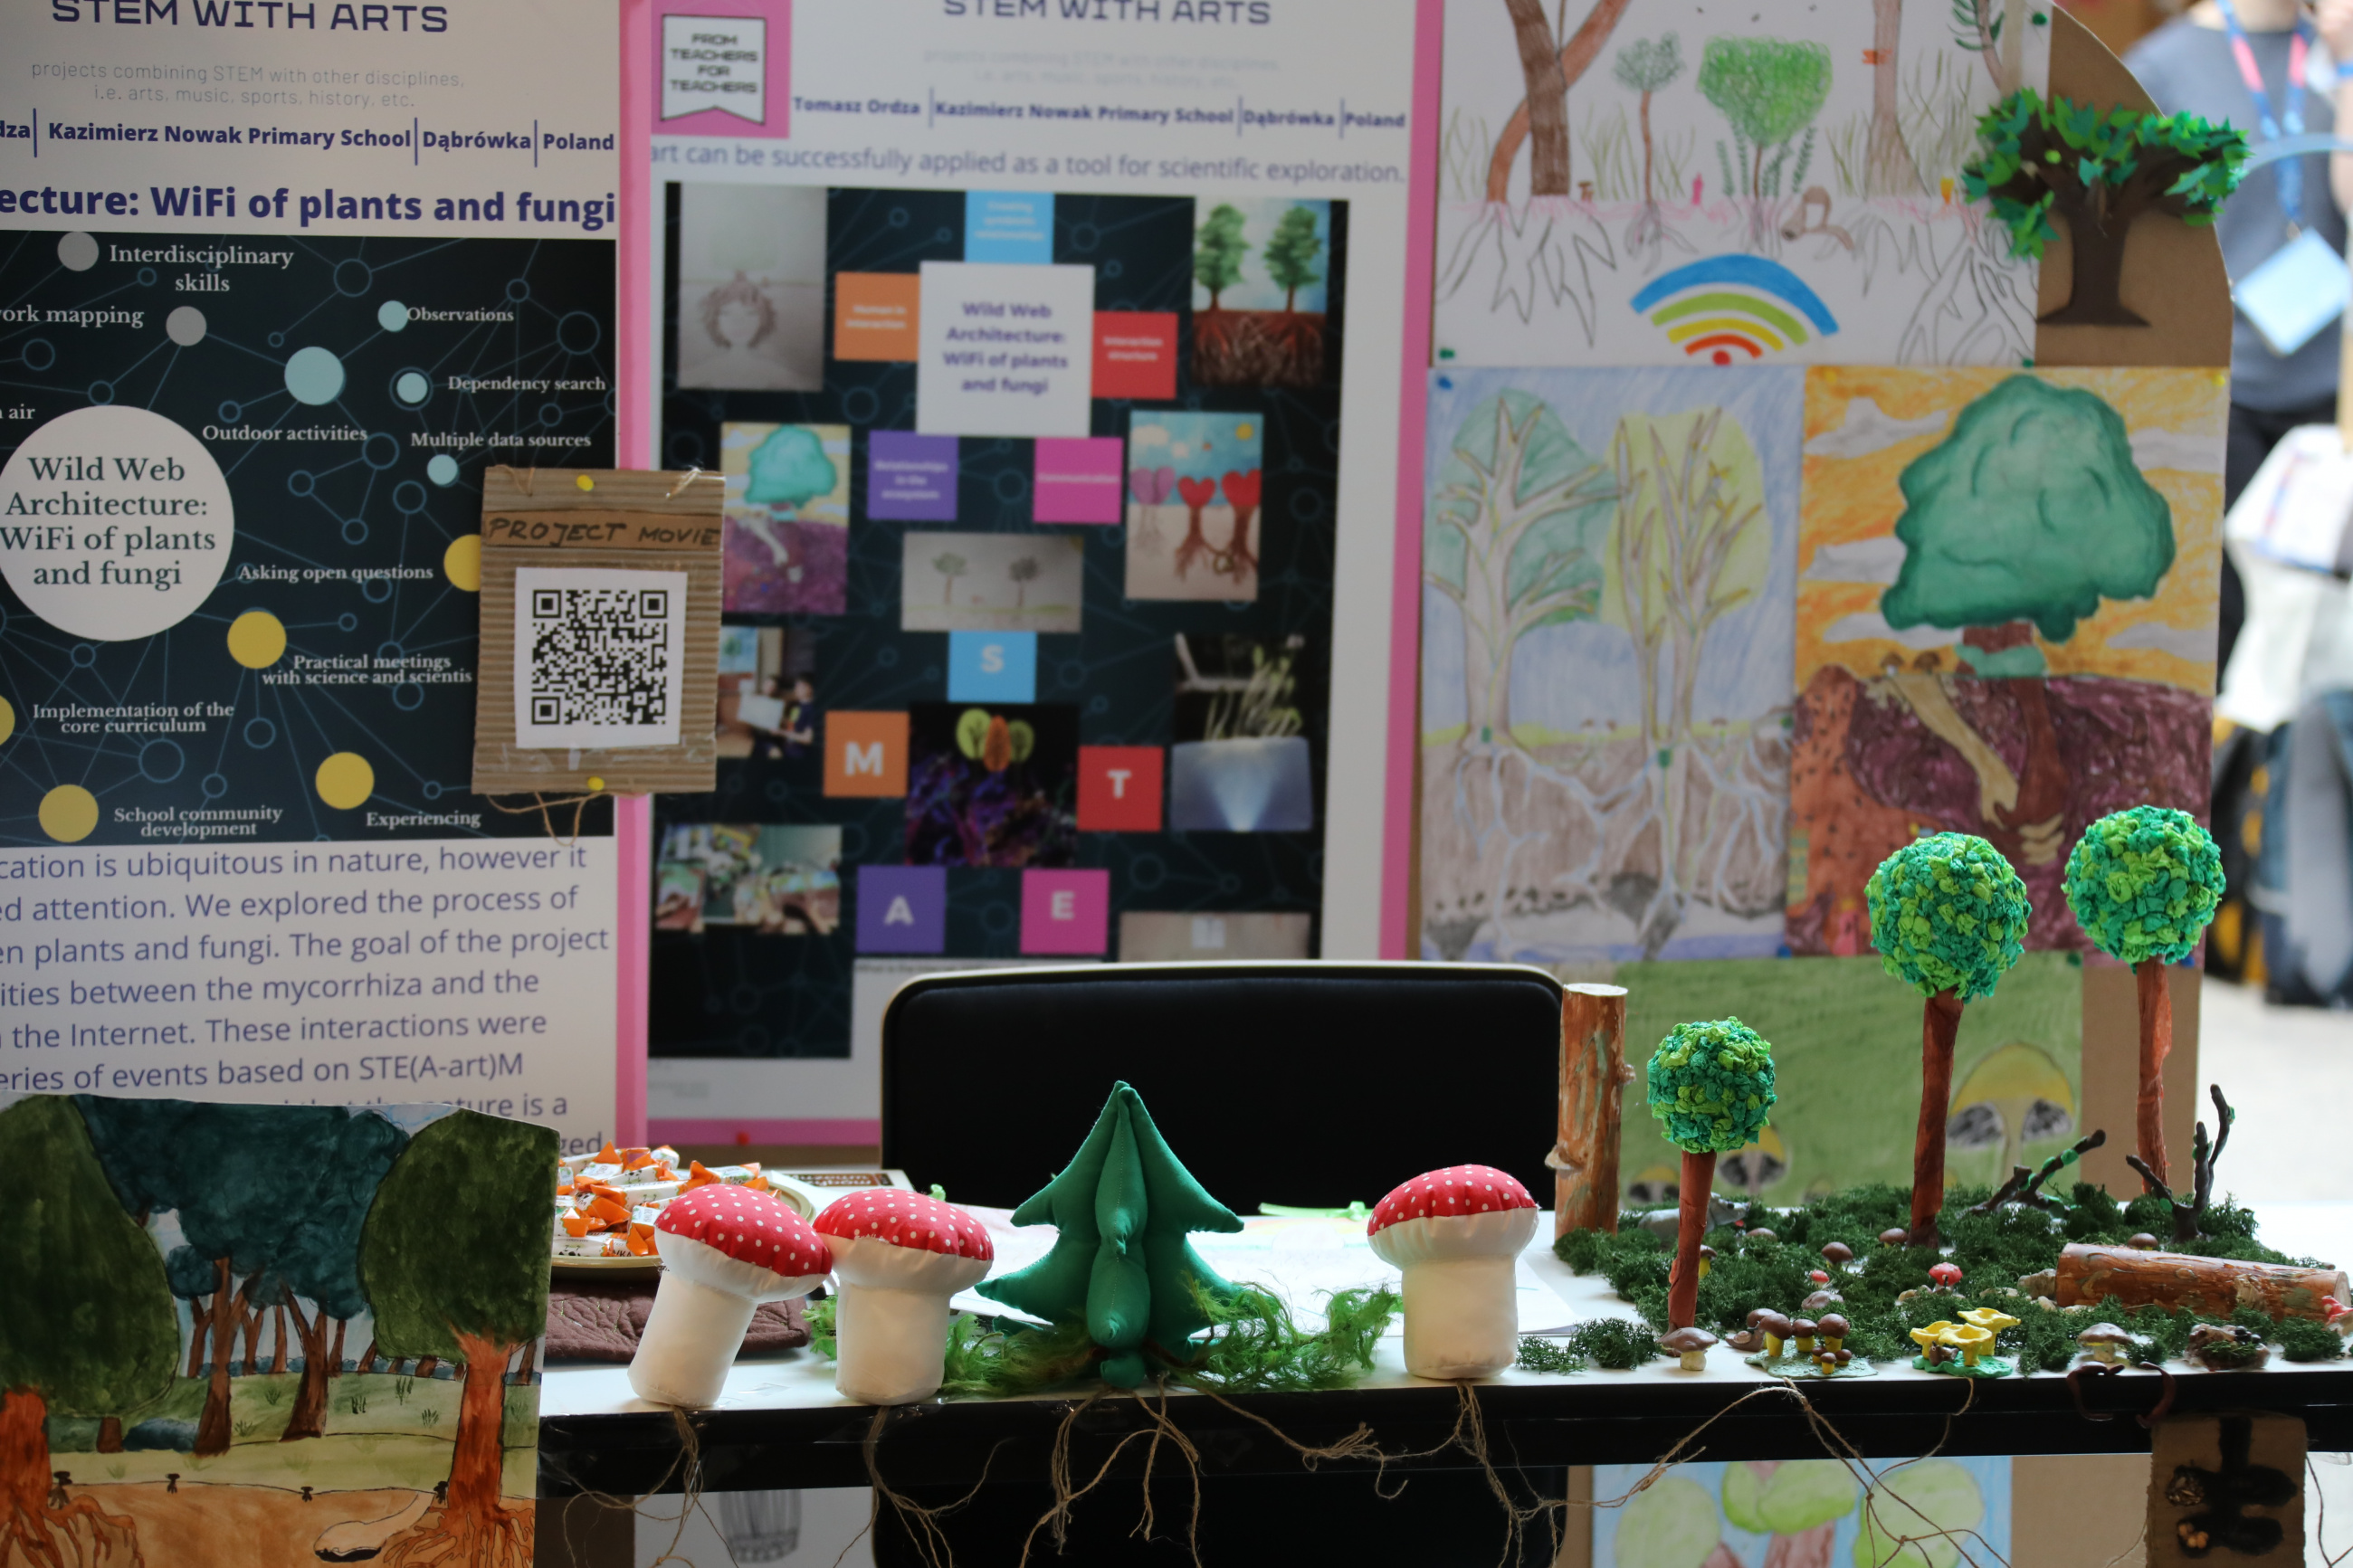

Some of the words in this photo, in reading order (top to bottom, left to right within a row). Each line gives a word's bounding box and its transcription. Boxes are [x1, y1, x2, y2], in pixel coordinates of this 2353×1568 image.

[52, 0, 177, 25] STEM
[193, 0, 315, 29] WITH
[330, 4, 448, 33] ARTS
[944, 0, 1046, 20] STEM
[1060, 0, 1158, 24] WITH
[1173, 2, 1271, 26] ARTS
[692, 33, 738, 47] FROM
[672, 49, 757, 62] TEACHERS
[33, 62, 107, 80] projects
[113, 65, 206, 83] combining
[214, 65, 262, 81] STEM
[270, 67, 307, 83] with
[312, 69, 359, 85] other
[365, 70, 464, 89] disciplines,
[698, 63, 731, 78] FOR
[95, 85, 121, 100] i.e.
[129, 87, 168, 102] arts,
[176, 88, 233, 104] music,
[242, 89, 302, 107] sports,
[310, 90, 376, 109] history,
[381, 92, 414, 108] etc.
[670, 79, 757, 94] TEACHERS
[794, 96, 861, 113] Tomasz
[867, 99, 921, 115] Ordza
[1029, 104, 1091, 119] Nowak
[1097, 105, 1169, 125] Primary
[1175, 108, 1234, 123] School
[1344, 111, 1405, 128] Poland
[49, 122, 157, 141] Kazimierz
[165, 126, 242, 144] Nowak
[248, 127, 335, 150] Primary
[340, 129, 411, 147] School
[423, 131, 531, 152] Dąbrówka
[543, 133, 614, 150] Poland
[686, 147, 729, 165] can
[736, 145, 765, 166] be
[772, 147, 912, 175] successfully
[919, 149, 1006, 176] applied
[1014, 158, 1039, 175] as
[1046, 159, 1059, 176] a
[1066, 155, 1111, 177] tool
[1118, 155, 1154, 178] for
[1158, 157, 1260, 181] scientific
[1266, 159, 1406, 186] exploration.
[0, 186, 138, 215] ecture:
[150, 185, 235, 217] WiFi
[248, 187, 289, 218] of
[300, 188, 422, 228] plants
[433, 191, 504, 221] and
[516, 192, 615, 232] fungi
[109, 245, 294, 270] Interdisciplinary
[176, 274, 230, 292] skills
[0, 304, 41, 322] ork
[47, 306, 144, 328] mapping
[406, 307, 514, 321] Observations
[448, 376, 549, 394] Dependency
[554, 376, 605, 391] search
[9, 404, 35, 419] air
[203, 425, 282, 441] Outdoor
[287, 425, 367, 441] activities
[411, 432, 484, 451] Multiple
[489, 432, 523, 447] data
[529, 434, 591, 448] sources
[28, 457, 105, 481] Wild
[114, 457, 185, 481] Web
[6, 492, 207, 517] Architecture:
[0, 528, 75, 551] WiFi
[84, 527, 119, 551] of
[124, 528, 215, 555] plants
[488, 518, 626, 546] PROJECT
[638, 527, 720, 546] MOVIE
[33, 563, 91, 585] and
[100, 562, 182, 590] fungi
[239, 565, 299, 583] Asking
[303, 567, 348, 581] open
[351, 565, 433, 581] questions
[293, 654, 368, 670] Practical
[373, 656, 451, 672] meetings
[980, 645, 1004, 673] S
[262, 670, 300, 686] with
[305, 670, 367, 684] science
[373, 670, 405, 683] and
[409, 670, 472, 684] scientis
[33, 703, 178, 721] Implementation
[183, 702, 203, 717] of
[207, 702, 234, 716] the
[61, 720, 100, 733] core
[105, 717, 205, 733] curriculum
[845, 741, 883, 775] M
[1108, 770, 1132, 799] T
[114, 807, 176, 822] School
[179, 806, 282, 823] community
[366, 811, 481, 829] Experiencing
[141, 822, 257, 839] development
[95, 853, 117, 877] is
[127, 850, 283, 882] ubiquitous
[293, 849, 318, 874] in
[328, 851, 430, 876] nature,
[440, 848, 560, 870] however
[568, 847, 586, 869] it
[33, 895, 176, 920] attention.
[185, 893, 231, 917] We
[240, 889, 367, 921] explored
[377, 889, 422, 912] the
[432, 891, 542, 917] process
[550, 885, 579, 909] of
[885, 897, 915, 926] A
[1051, 892, 1075, 921] E
[33, 935, 124, 969] plants
[135, 935, 188, 960] and
[198, 933, 280, 965] fungi.
[288, 933, 341, 956] The
[351, 930, 411, 962] goal
[420, 929, 449, 954] of
[456, 928, 501, 952] the
[510, 928, 607, 959] project
[71, 977, 196, 1004] between
[205, 976, 252, 1001] the
[262, 973, 422, 1003] mycorrhiza
[432, 970, 484, 996] and
[494, 970, 538, 993] the
[13, 1023, 60, 1049] the
[71, 1020, 195, 1047] Internet.
[204, 1018, 291, 1043] These
[300, 1013, 469, 1040] interactions
[478, 1014, 547, 1036] were
[74, 1061, 105, 1088] of
[114, 1061, 207, 1087] events
[218, 1057, 303, 1084] based
[314, 1060, 349, 1082] on
[358, 1051, 523, 1080] STE(A-art)M
[522, 1091, 544, 1117] is
[552, 1094, 567, 1117] a
